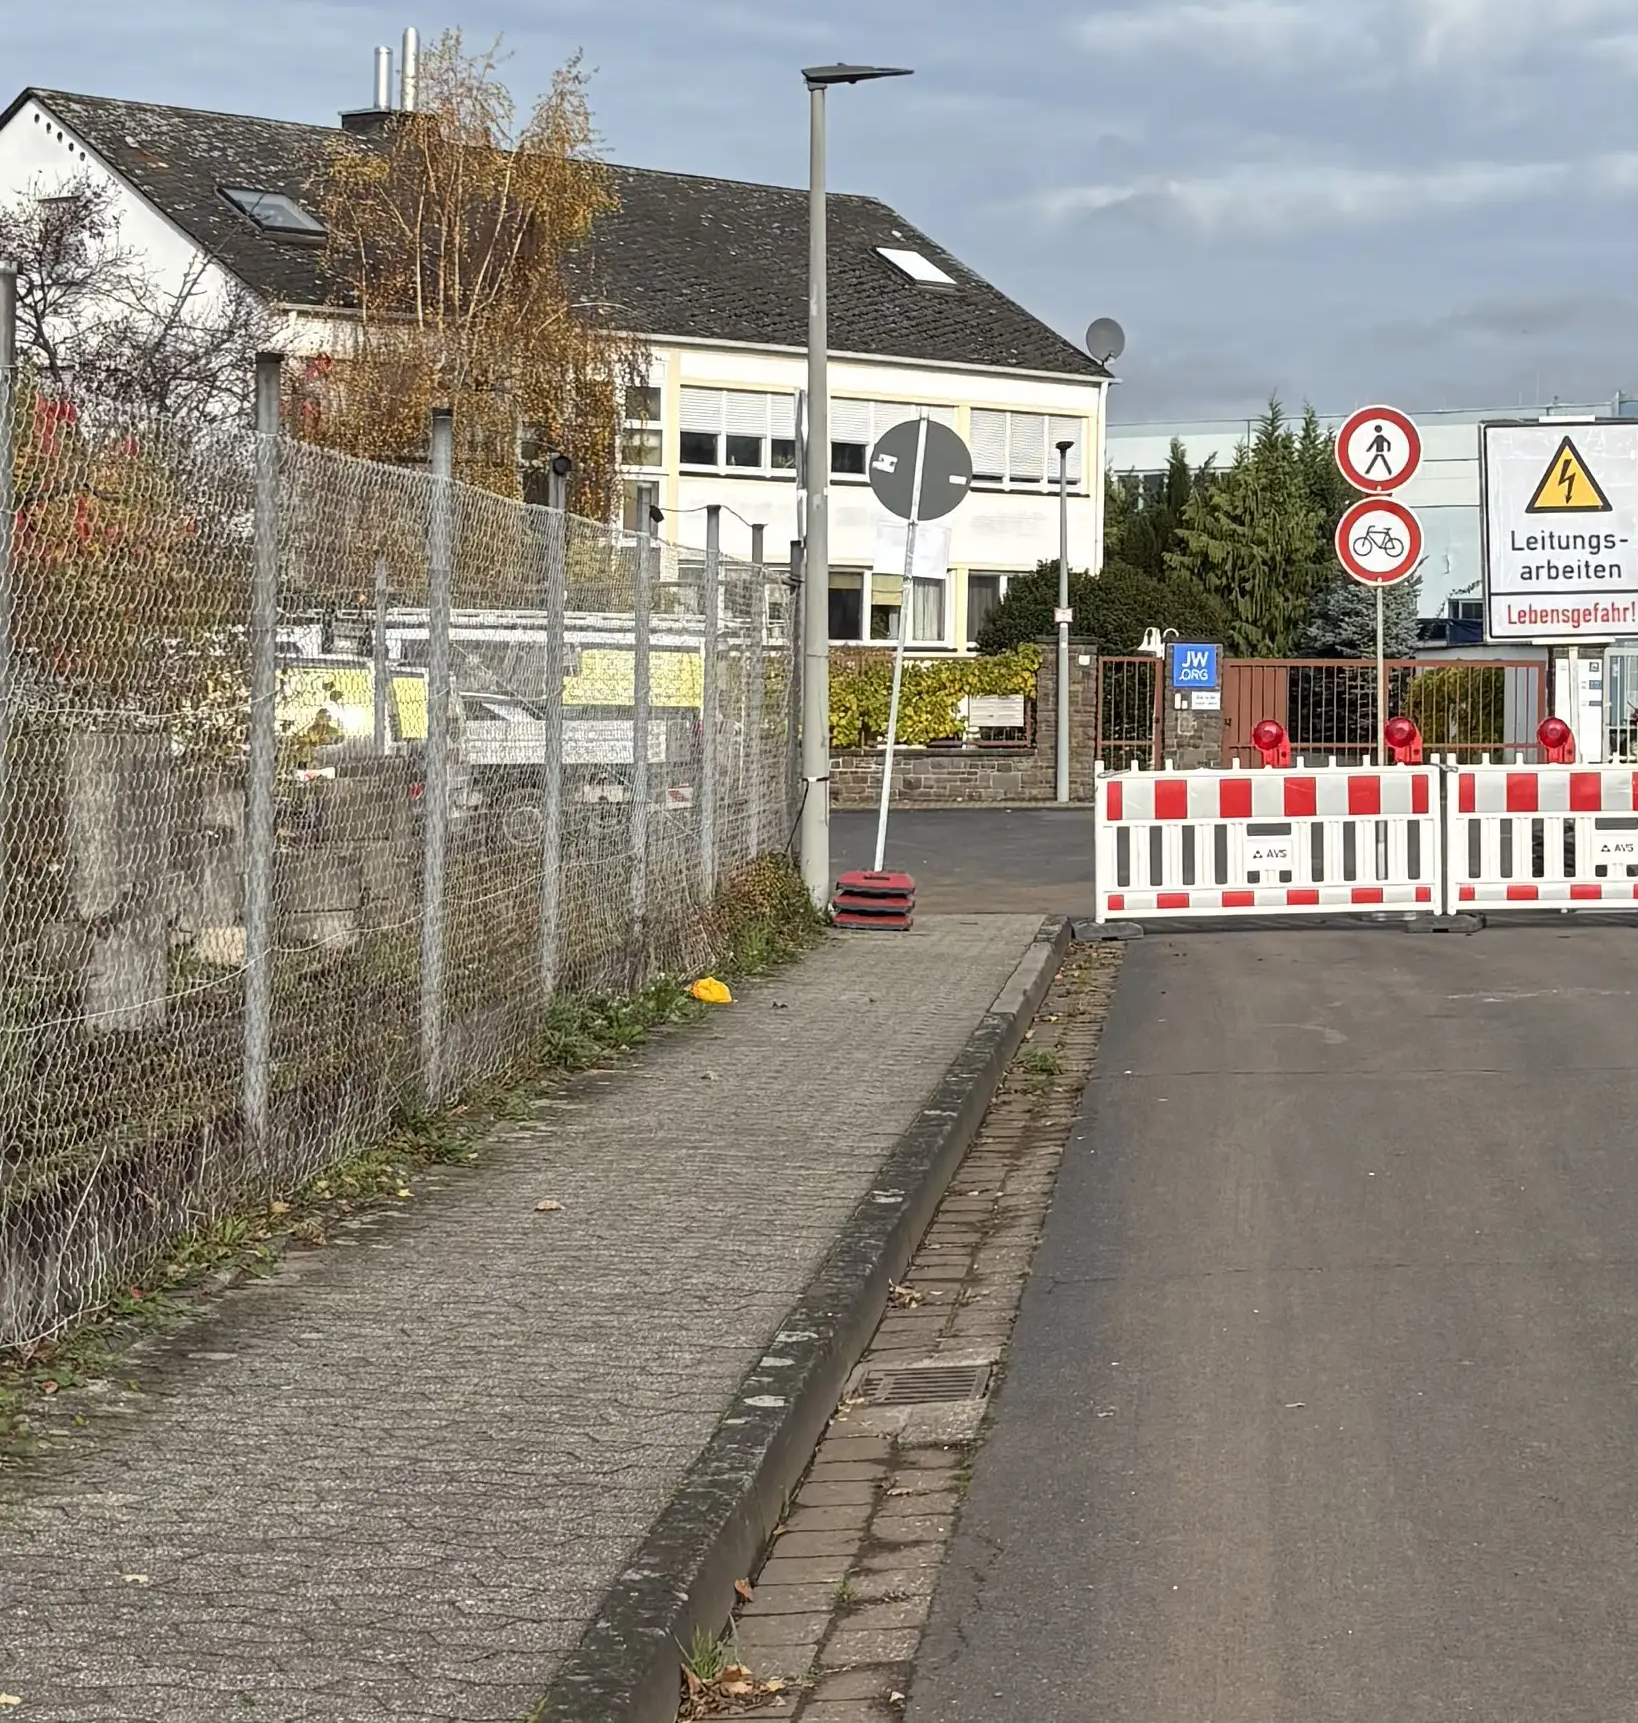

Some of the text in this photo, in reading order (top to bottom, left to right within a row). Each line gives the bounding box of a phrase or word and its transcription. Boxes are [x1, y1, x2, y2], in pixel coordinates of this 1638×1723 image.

[1510, 530, 1629, 555] Leitungs-
[1520, 559, 1622, 581] arbeiten
[1507, 601, 1636, 628] Lebensgefahr!
[1181, 650, 1209, 667] JW
